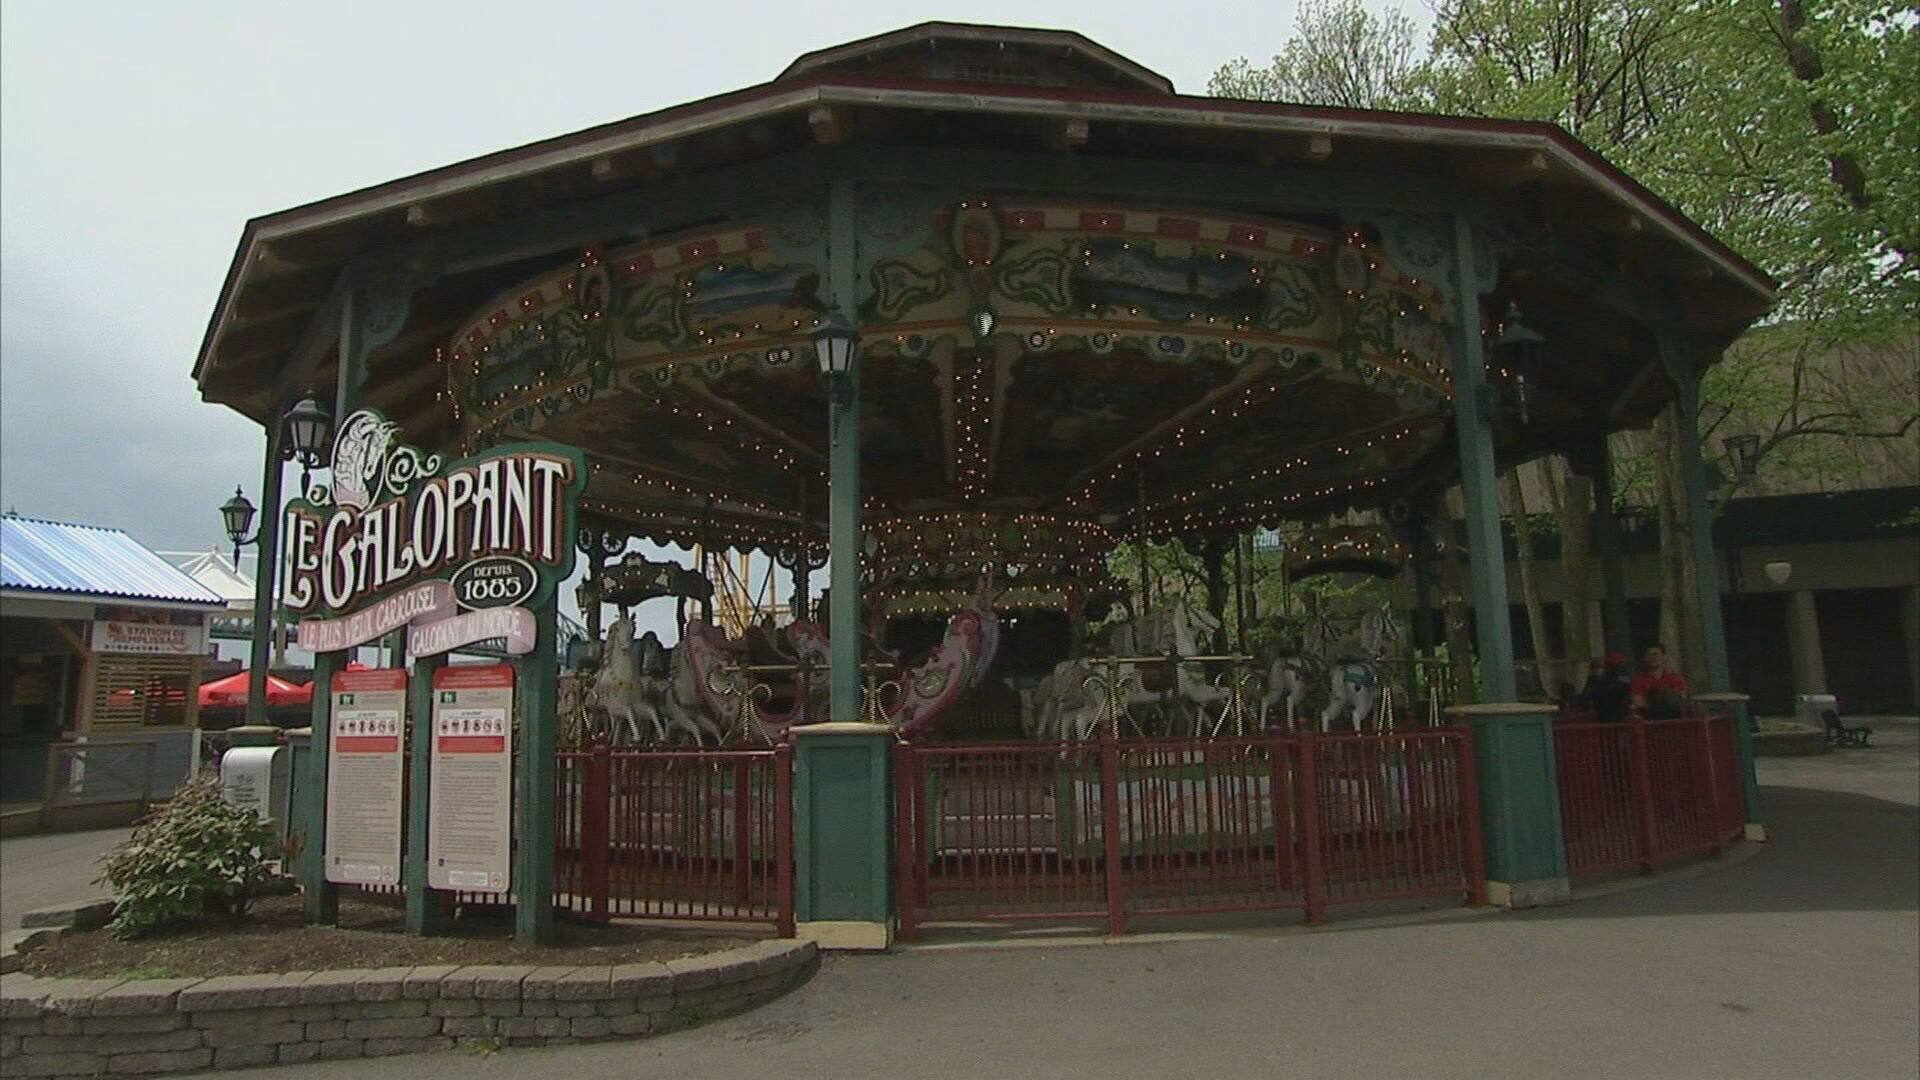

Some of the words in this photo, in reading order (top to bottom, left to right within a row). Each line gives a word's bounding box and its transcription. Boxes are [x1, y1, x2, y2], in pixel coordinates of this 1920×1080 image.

[322, 458, 564, 609] GALOPANT
[473, 564, 513, 577] DEPUIS
[302, 622, 318, 650] LE
[320, 622, 341, 649] PLUS
[344, 608, 374, 646] VIEUX
